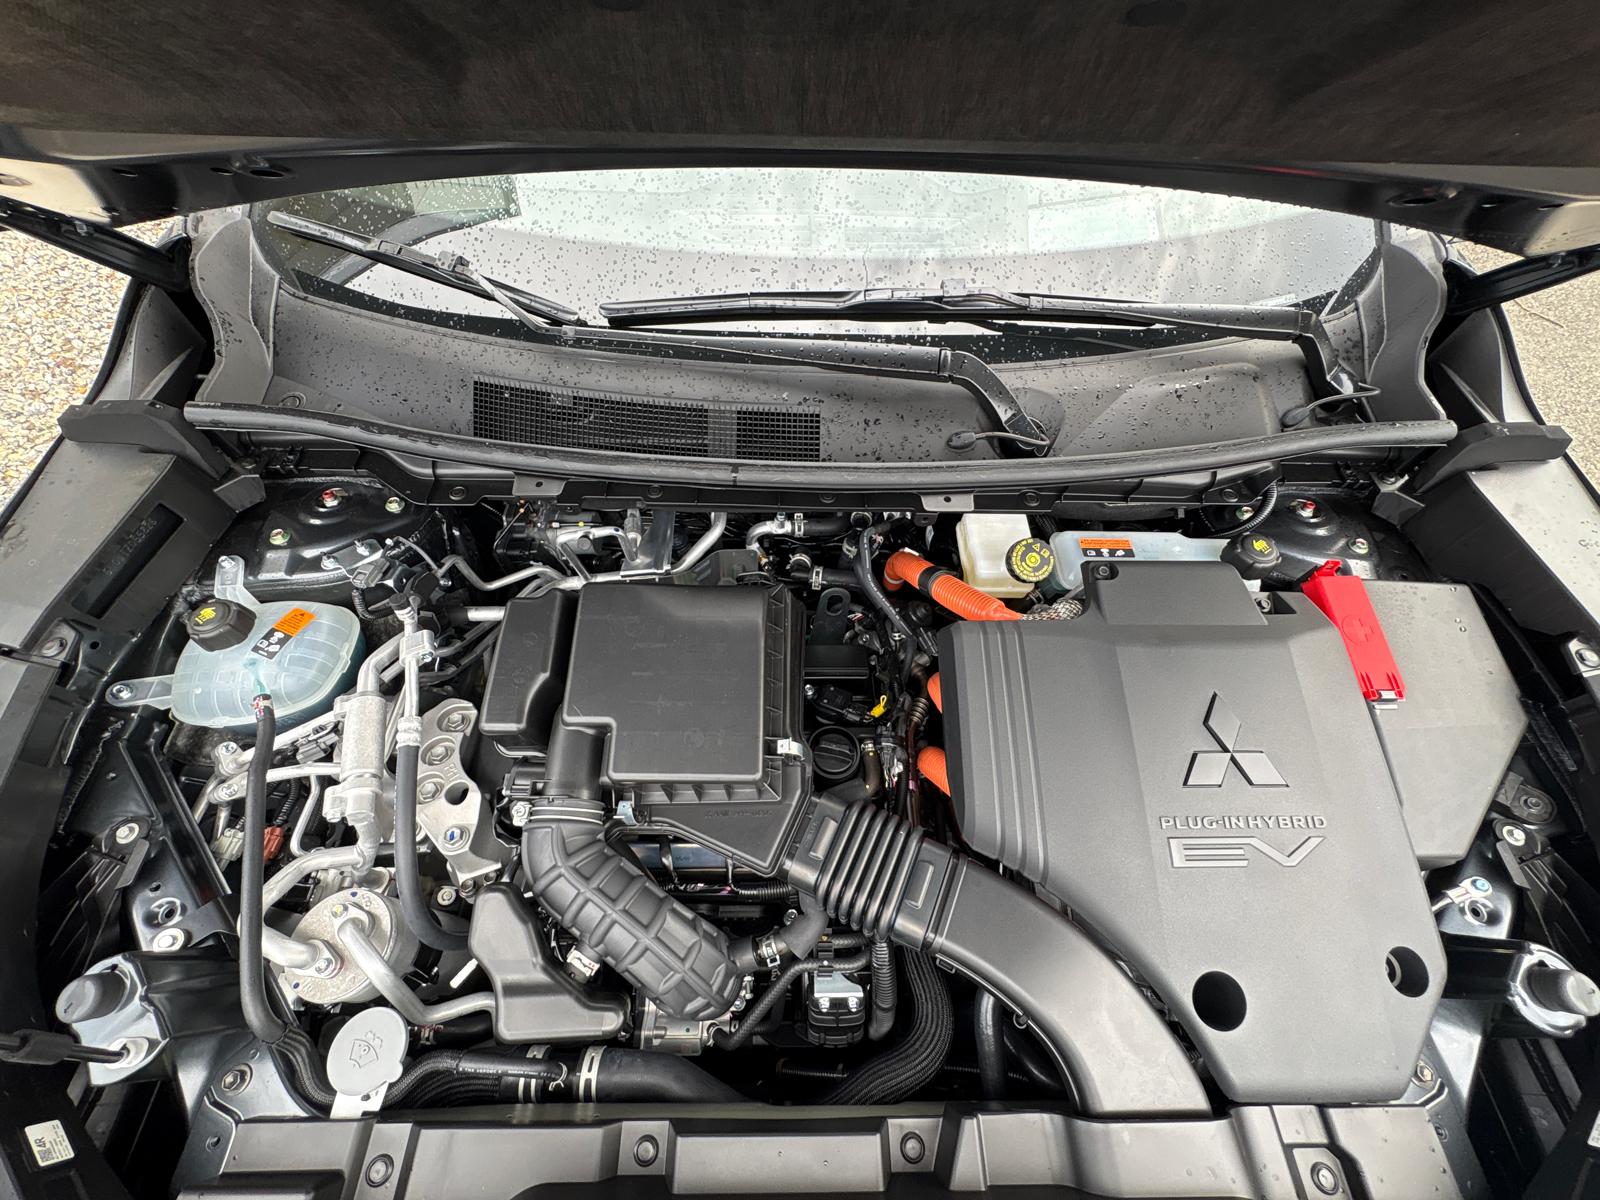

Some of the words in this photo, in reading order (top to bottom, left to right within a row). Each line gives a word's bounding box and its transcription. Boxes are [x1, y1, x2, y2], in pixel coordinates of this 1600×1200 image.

[1159, 815, 1244, 830] PLUG-IN
[1246, 815, 1328, 830] HYBRID
[1167, 836, 1327, 868] EV
[34, 1136, 47, 1148] 4R
